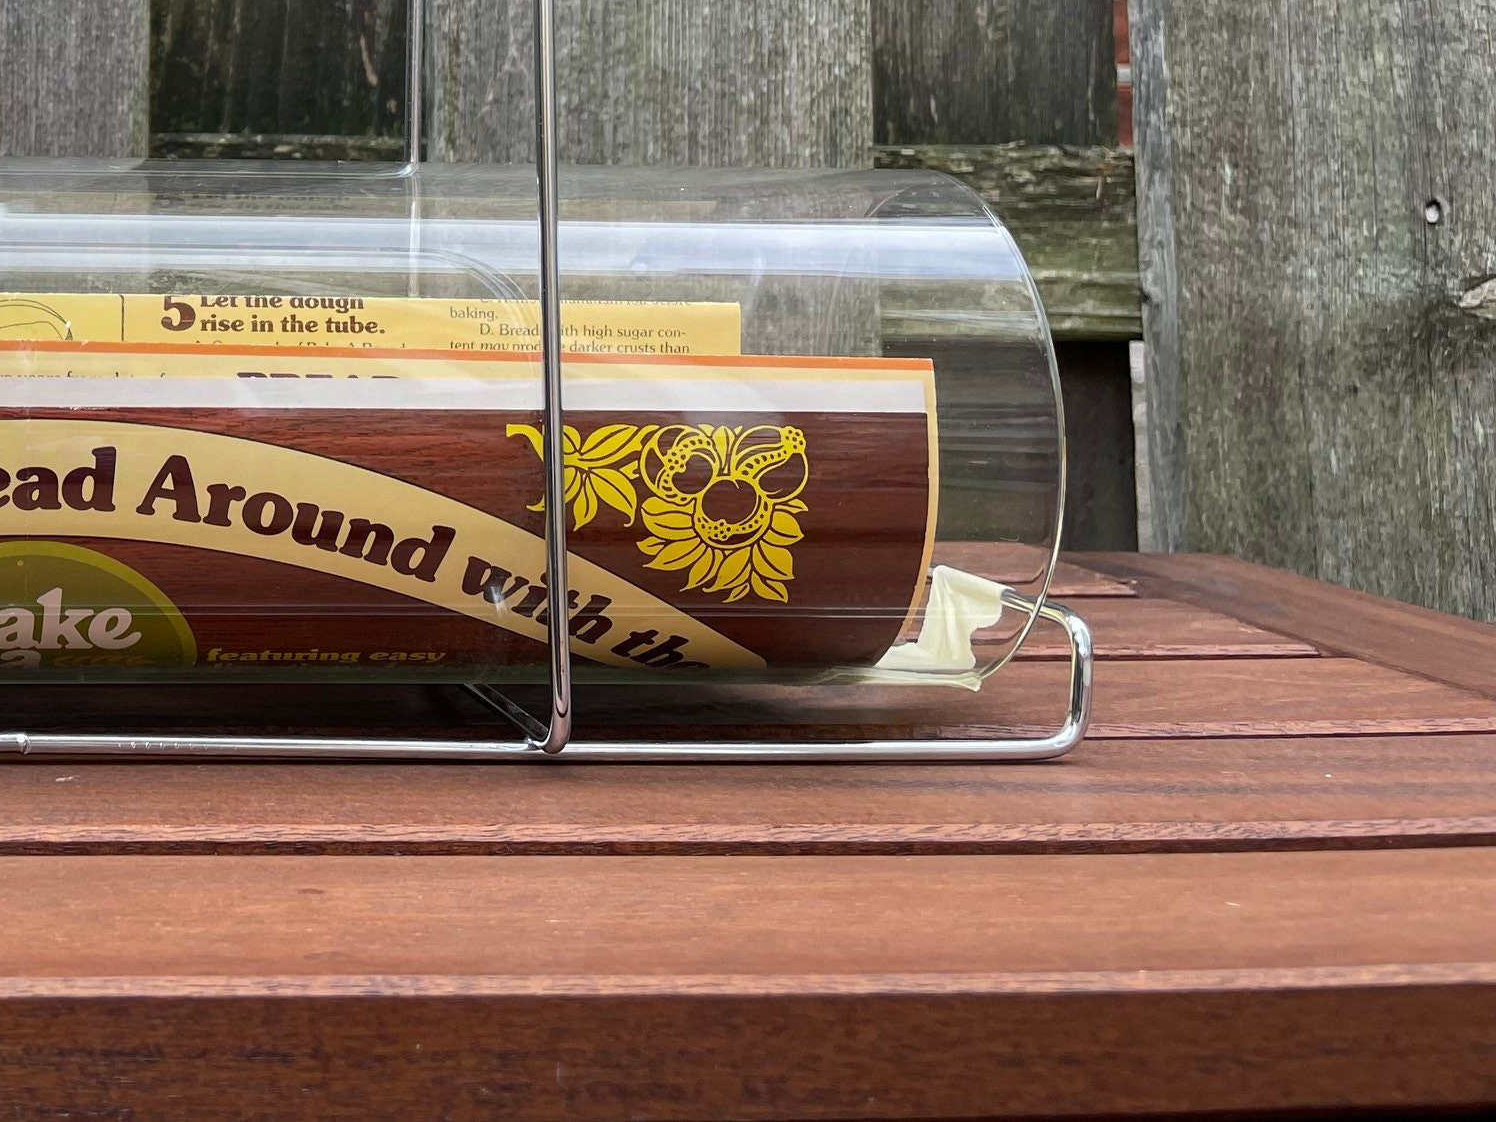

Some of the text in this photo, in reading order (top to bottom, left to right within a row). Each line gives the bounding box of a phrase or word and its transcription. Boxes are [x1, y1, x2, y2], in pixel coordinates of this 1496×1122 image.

[160, 295, 196, 332] 5
[449, 306, 499, 320] baking.
[200, 315, 386, 335] rise in the tube.
[583, 325, 612, 339] high
[617, 328, 654, 339] sugar
[657, 329, 686, 338] con-
[569, 340, 612, 353] darker
[616, 342, 656, 353] crusts
[659, 341, 690, 354] than
[136, 454, 457, 584] Around
[206, 647, 446, 663] featuring easy
